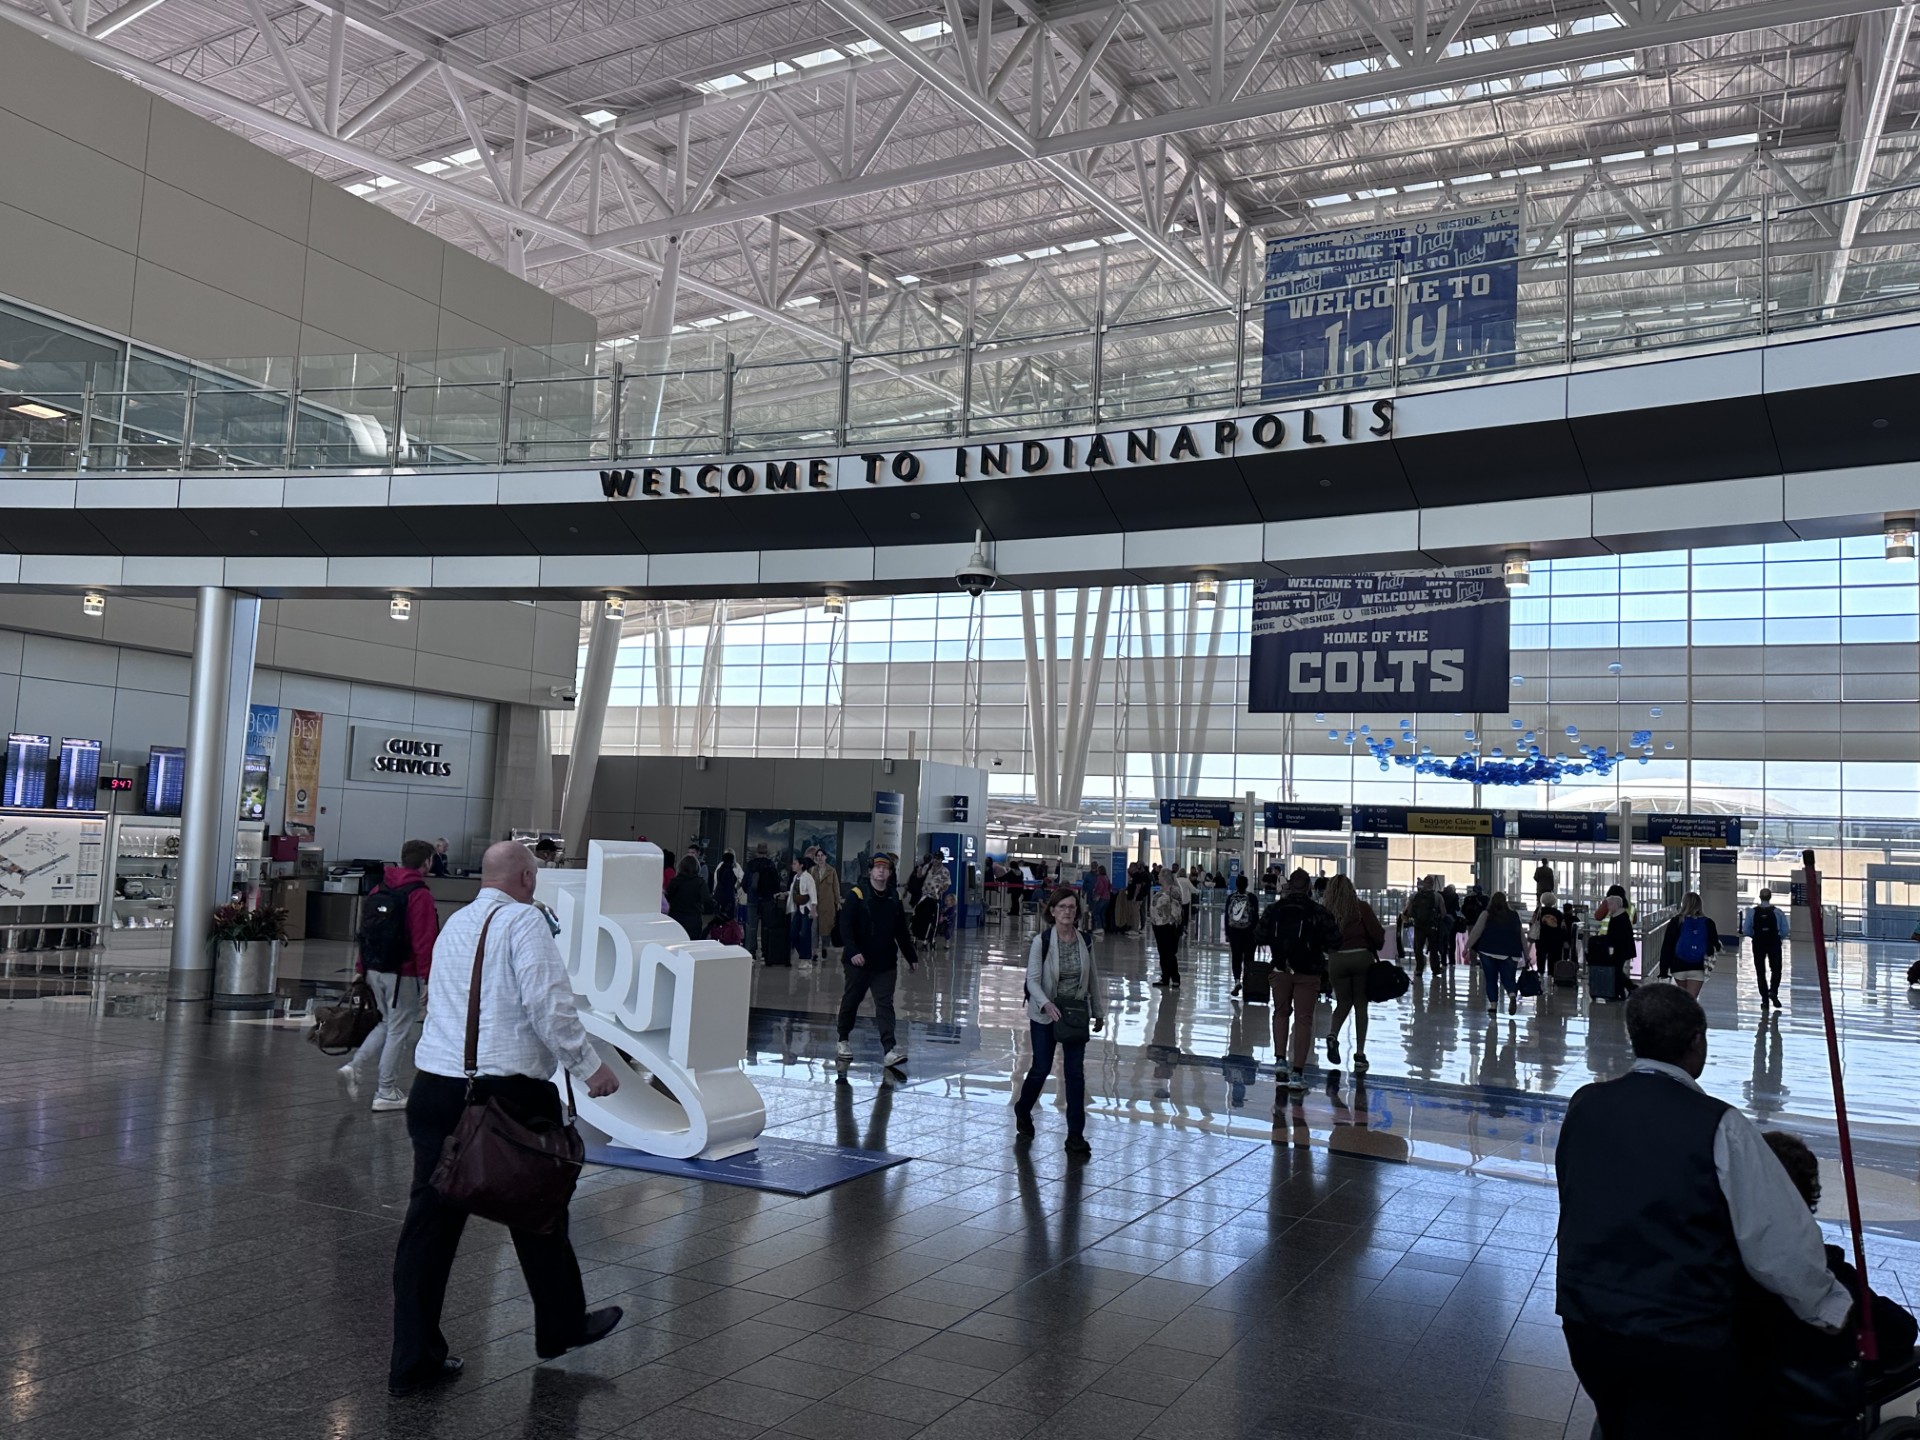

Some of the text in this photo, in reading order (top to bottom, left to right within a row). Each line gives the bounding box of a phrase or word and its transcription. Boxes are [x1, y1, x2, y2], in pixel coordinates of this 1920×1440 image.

[1298, 243, 1384, 267] WELCOME
[1389, 240, 1412, 255] TO
[1416, 229, 1455, 257] Indy
[1427, 255, 1449, 268] TO
[1266, 286, 1287, 299] TO
[1288, 273, 1490, 319] WELCOME TO
[1325, 302, 1448, 389] Indy
[600, 399, 1395, 498] WELCOME TO INDIANAPOLIS
[1465, 566, 1493, 578] SHOE
[1288, 578, 1352, 589] WELCOME
[1355, 579, 1373, 589] TO
[1361, 589, 1430, 605] WELCOME
[1432, 588, 1452, 599] TO
[1456, 581, 1485, 602] Indy
[1252, 600, 1291, 612] COME
[1293, 598, 1311, 609] TO
[1311, 591, 1342, 612] Indy
[1371, 604, 1398, 615] SHOE
[1309, 613, 1335, 624] SHOE
[1323, 630, 1429, 645] HOME OF THE
[1288, 648, 1465, 694] COLTS
[293, 717, 321, 740] BEST
[387, 738, 443, 757] GUEST
[375, 756, 451, 777] SERVICES
[111, 779, 132, 789] 9:47
[1419, 816, 1477, 826] Baggage Claim
